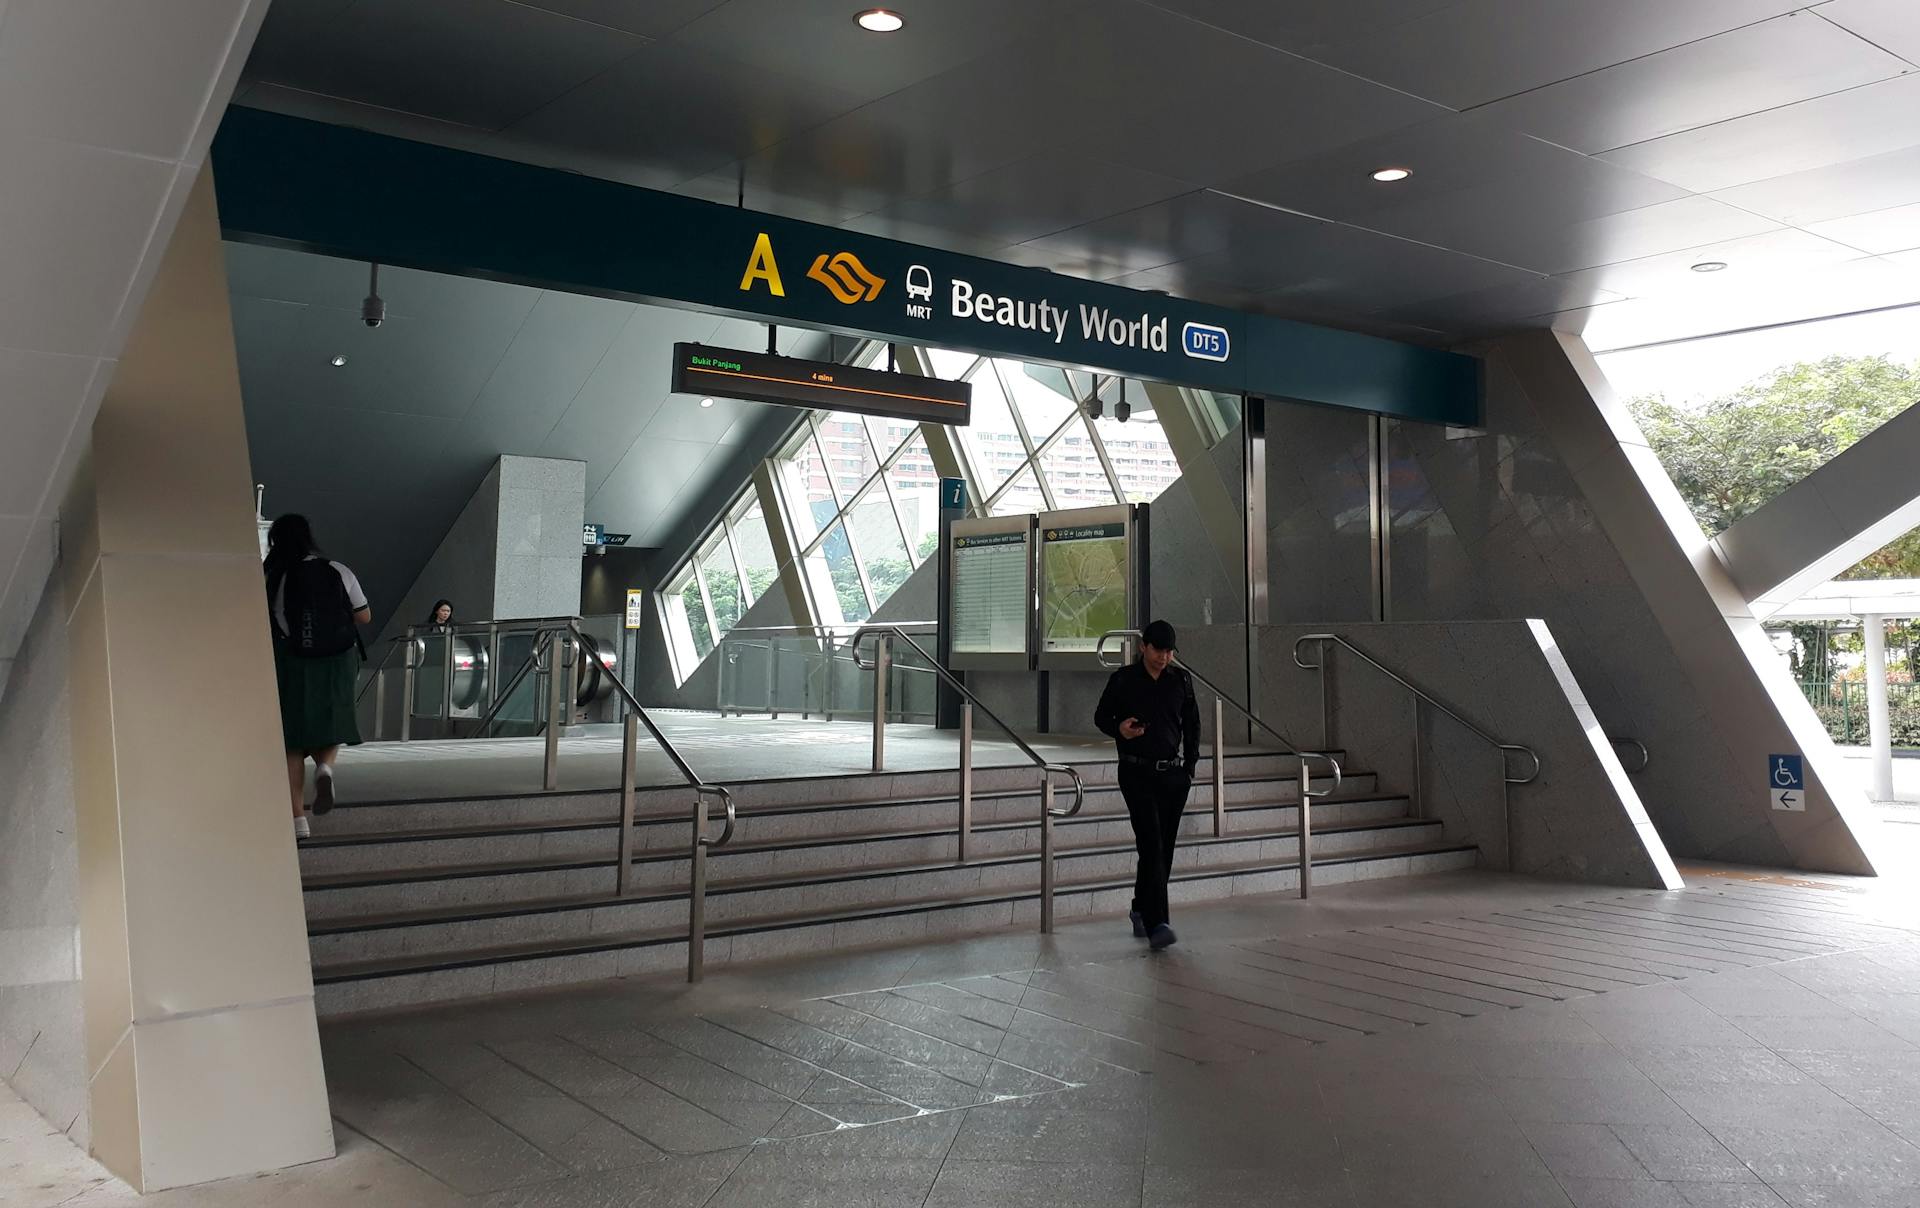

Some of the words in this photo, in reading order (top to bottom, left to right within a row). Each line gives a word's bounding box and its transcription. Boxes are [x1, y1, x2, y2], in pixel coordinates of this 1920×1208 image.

[740, 232, 785, 298] A
[906, 304, 933, 321] MRT
[951, 279, 1069, 344] Beauty
[1079, 303, 1168, 353] World
[1193, 331, 1220, 352] DT5
[692, 356, 711, 367] Bukit
[712, 359, 741, 371] Panjang
[812, 372, 818, 380] 4
[818, 374, 833, 383] mins
[1075, 530, 1093, 538] Locality
[1093, 529, 1105, 537] map
